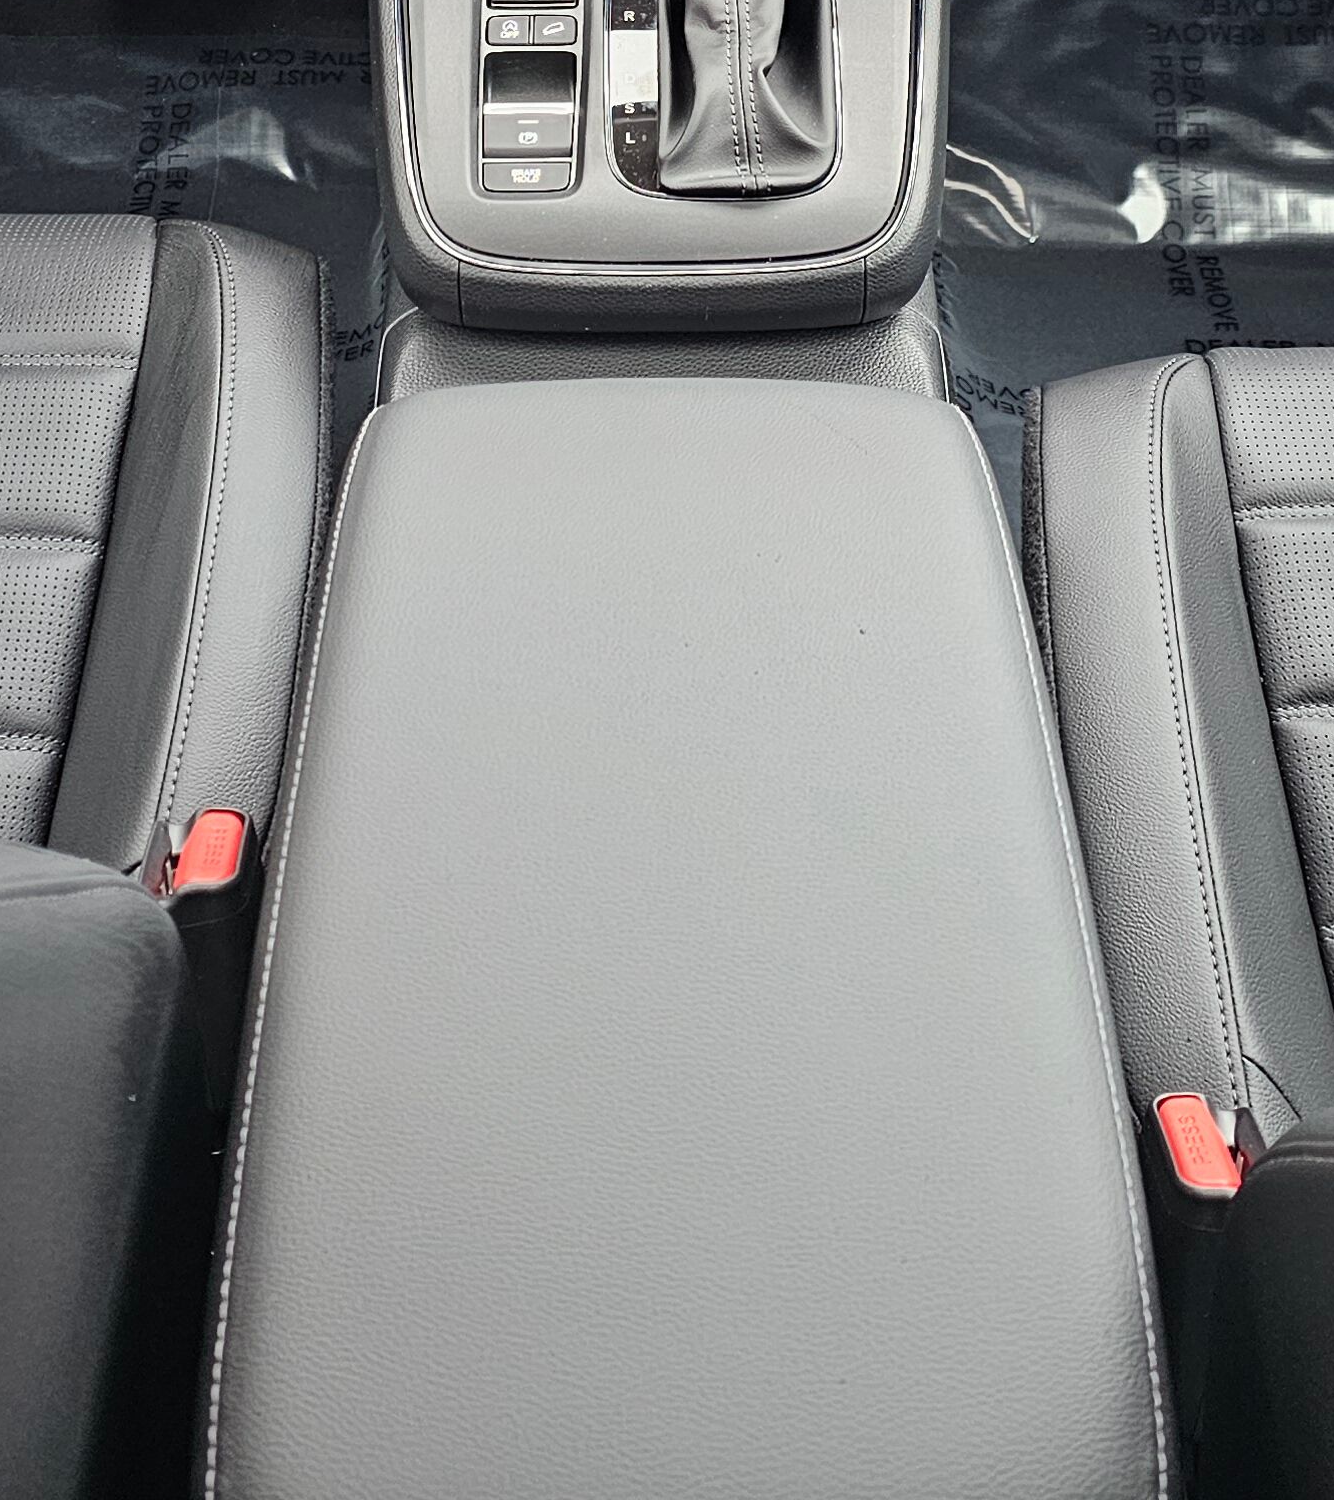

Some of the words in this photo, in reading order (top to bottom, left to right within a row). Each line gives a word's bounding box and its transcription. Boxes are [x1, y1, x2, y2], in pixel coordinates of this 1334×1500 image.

[623, 10, 636, 22] R
[500, 30, 520, 39] OFF
[1145, 21, 1267, 47] REMOVE
[199, 47, 296, 67] COVER
[145, 69, 257, 95] REMOVE
[273, 69, 344, 86] MUST
[624, 103, 635, 114] S
[1180, 55, 1209, 151] DEALER
[163, 102, 193, 190] DEALER
[625, 131, 636, 144] L
[1191, 168, 1216, 240] MUST
[1160, 219, 1195, 297] COVER
[1194, 255, 1240, 332] REMOVE
